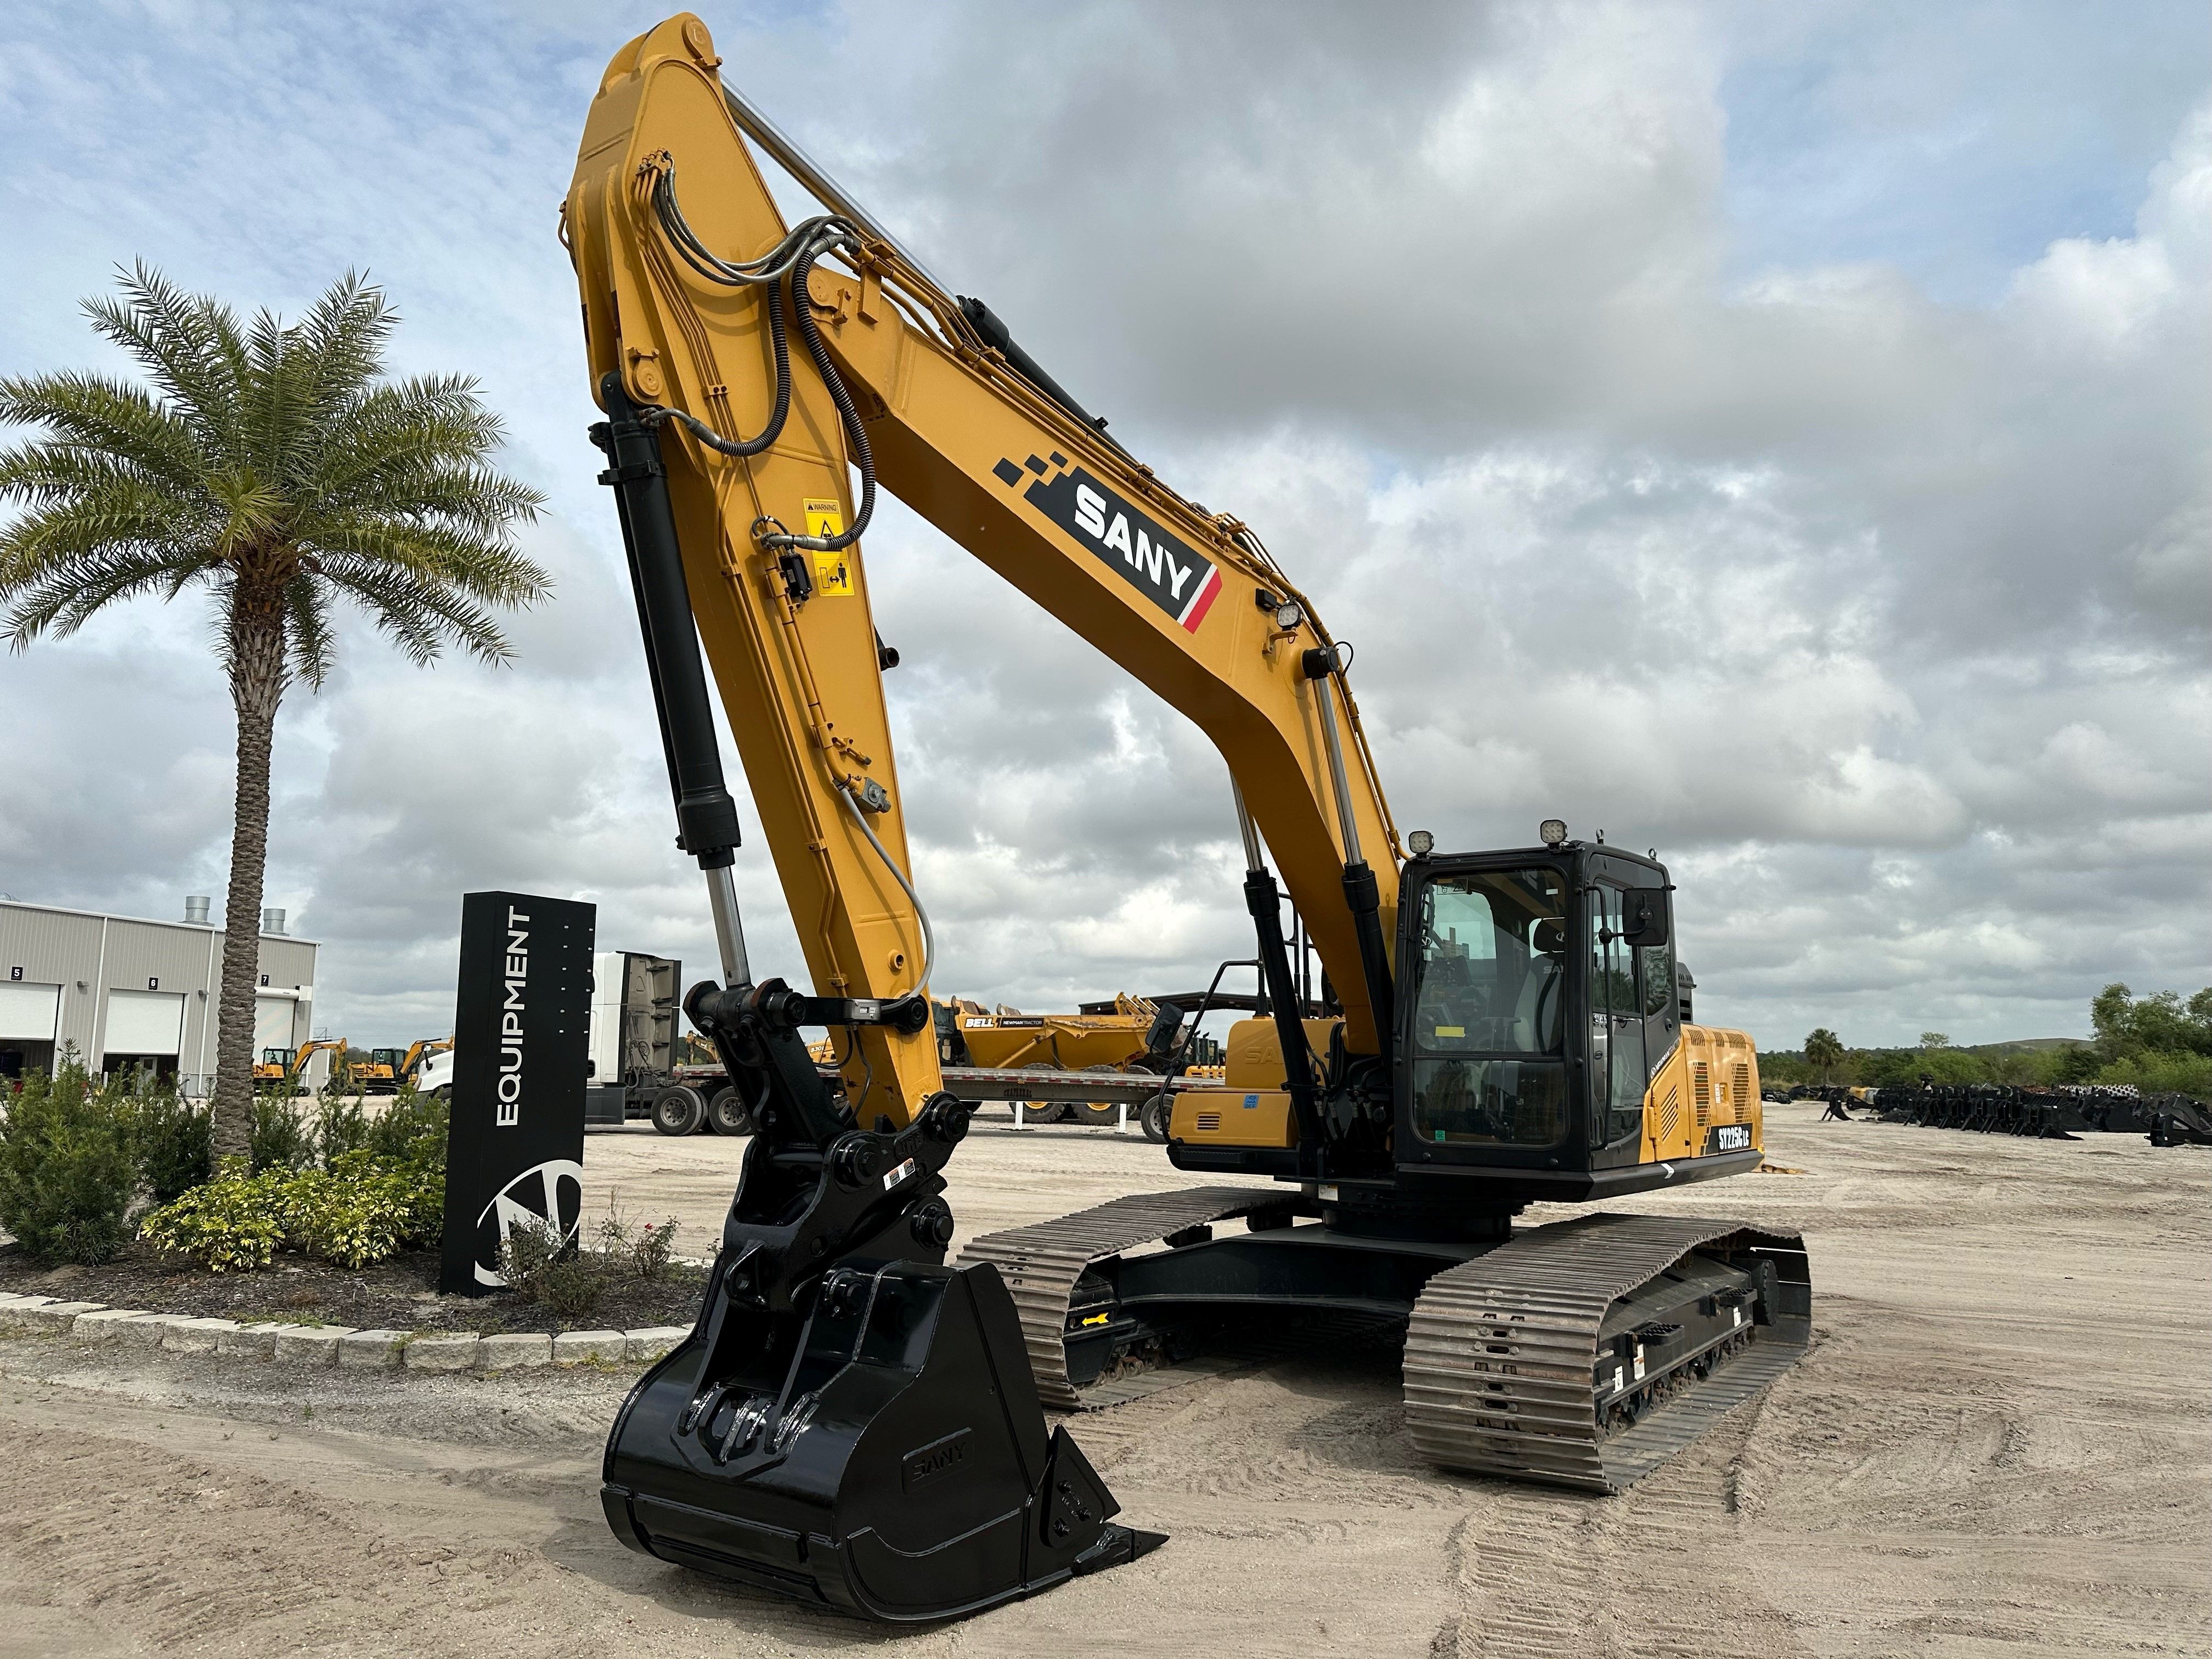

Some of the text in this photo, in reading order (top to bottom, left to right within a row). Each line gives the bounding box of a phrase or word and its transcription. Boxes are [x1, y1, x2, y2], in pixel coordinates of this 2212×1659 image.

[813, 503, 837, 511] WARNING
[1074, 483, 1193, 601] SANY
[496, 905, 530, 1126] EQUIPMENT
[965, 1018, 994, 1028] BELL
[1718, 1126, 1750, 1150] SY225C LC
[912, 1442, 966, 1481] SANY
